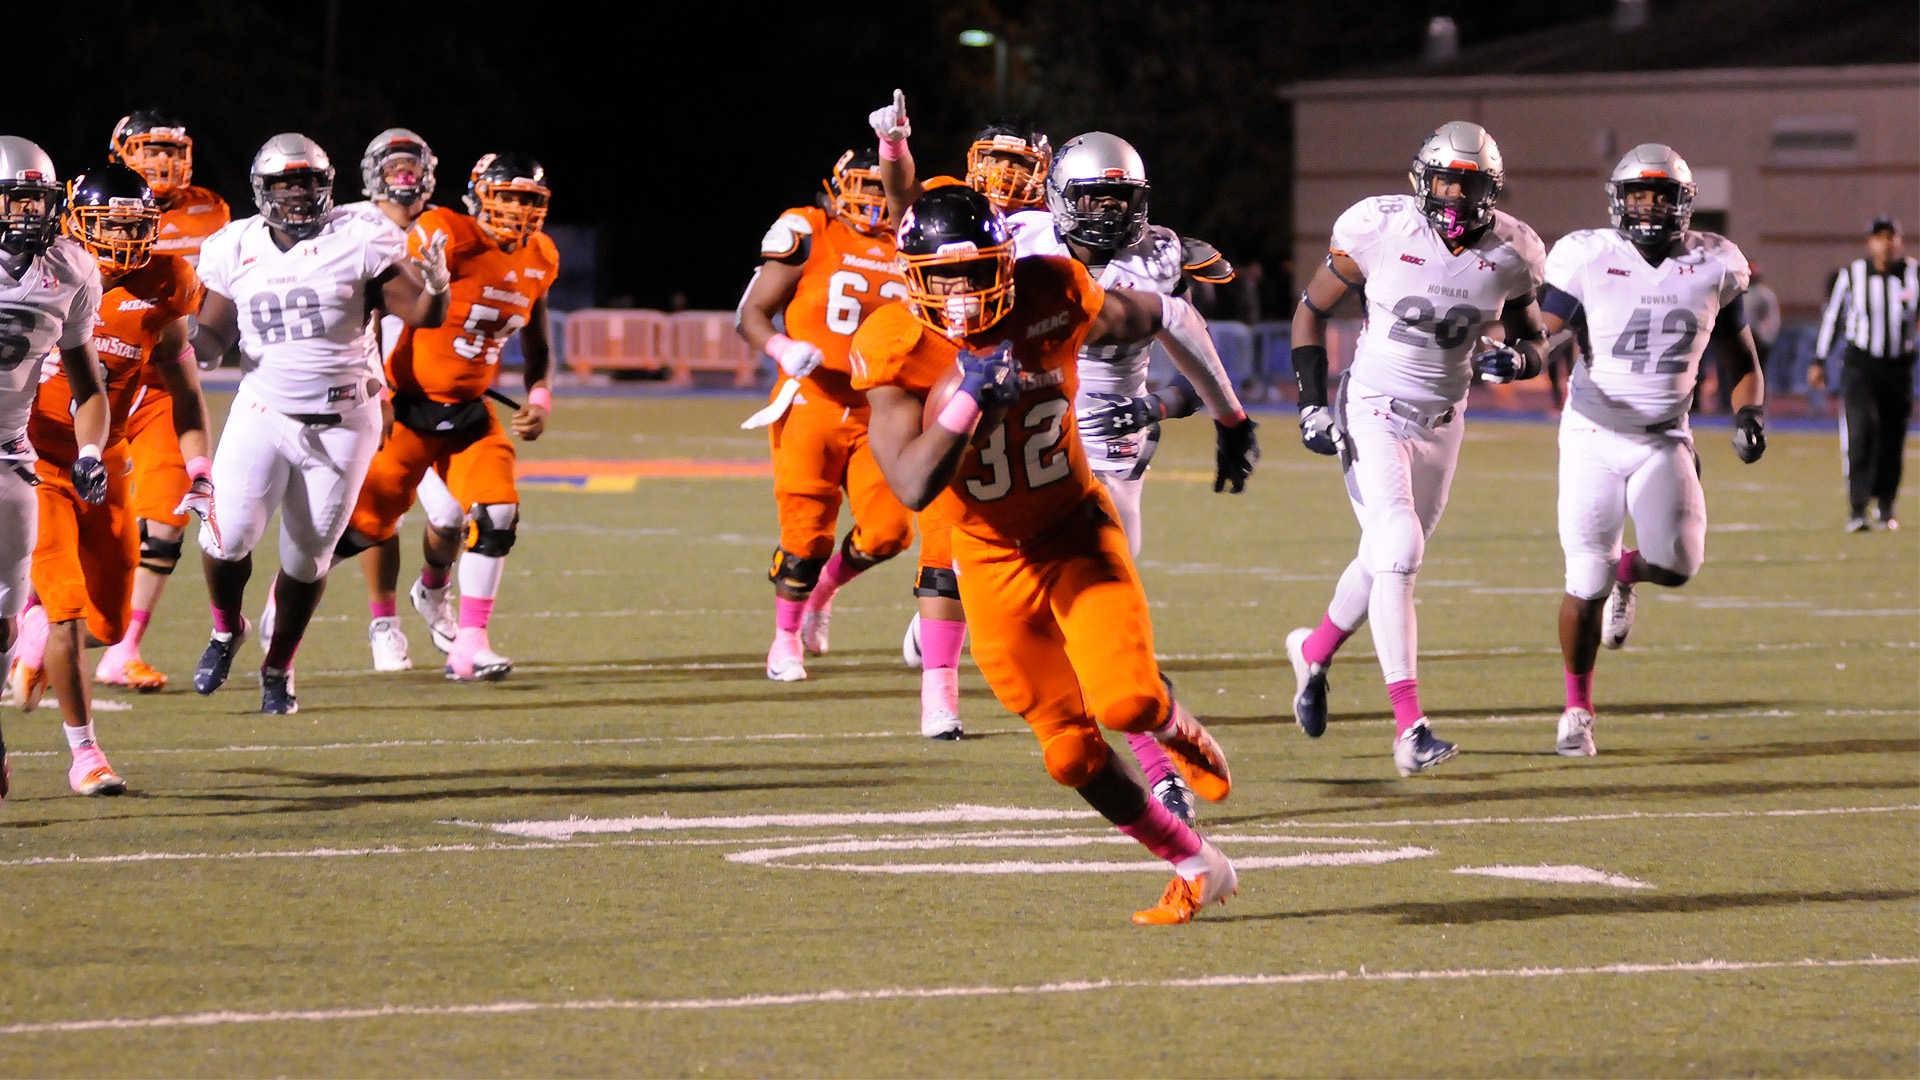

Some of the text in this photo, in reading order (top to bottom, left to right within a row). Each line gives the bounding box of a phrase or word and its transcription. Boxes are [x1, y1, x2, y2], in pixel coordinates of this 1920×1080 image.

[1427, 283, 1469, 299] HOWARD
[1640, 294, 1679, 305] HOWARD
[1612, 307, 1698, 375] 42
[965, 398, 1070, 501] 32
